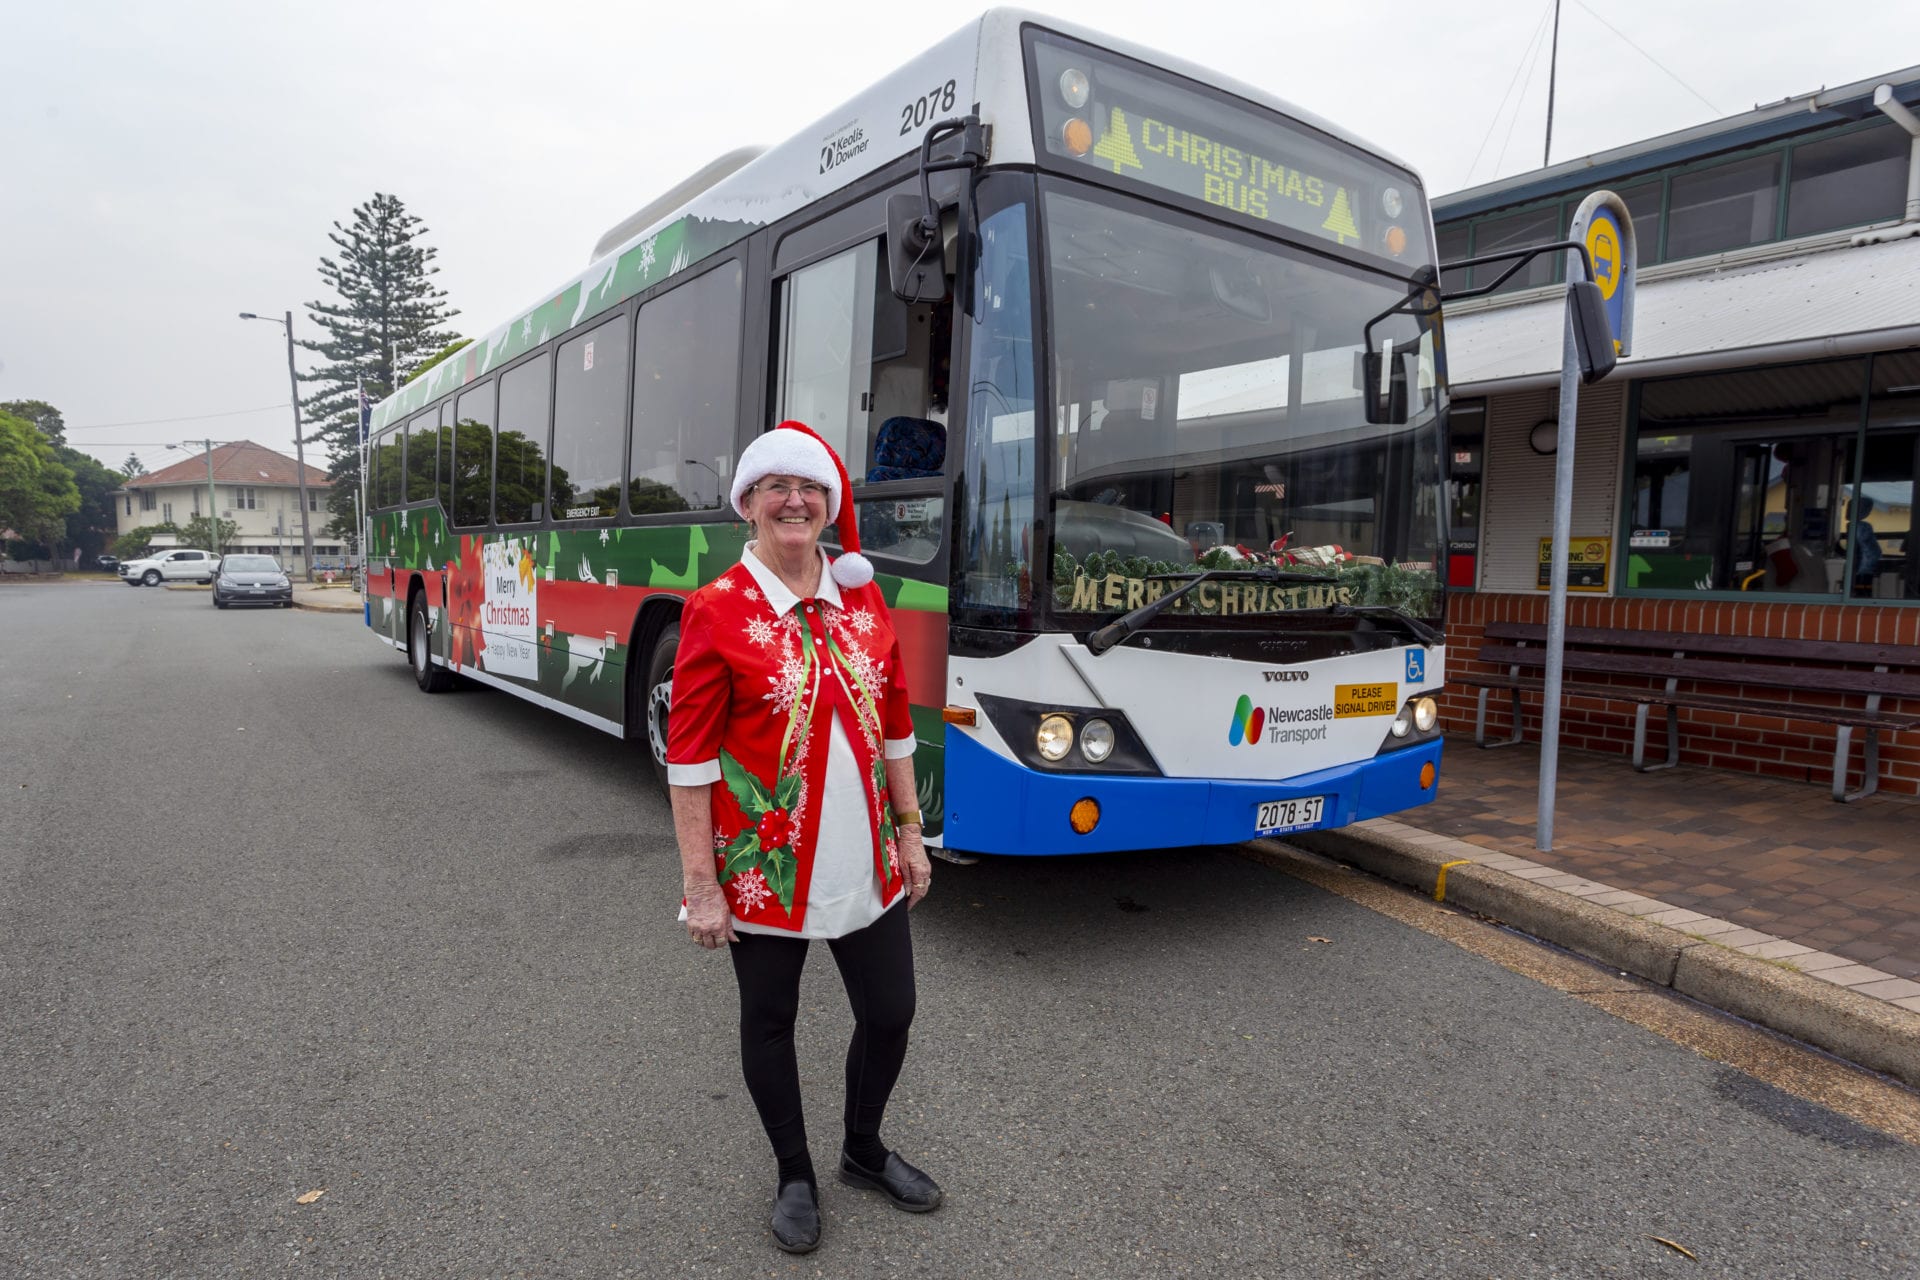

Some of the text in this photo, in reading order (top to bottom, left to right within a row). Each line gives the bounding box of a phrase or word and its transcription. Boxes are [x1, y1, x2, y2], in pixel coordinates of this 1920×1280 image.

[900, 79, 956, 137] 2078
[837, 128, 863, 152] Keolis
[836, 139, 869, 166] Downer
[1142, 118, 1324, 207] CHRISTMAS
[1204, 173, 1269, 220] BUS
[566, 507, 600, 518] EMERGENCY EXIT
[496, 575, 517, 598] Merry
[1199, 580, 1351, 615] CHRISTMAS
[486, 600, 530, 626] Christmas
[1262, 670, 1309, 682] VOLVO
[1352, 687, 1382, 699] PLEASE
[1268, 704, 1333, 724] Newcastle
[1335, 700, 1396, 715] SIGNAL DRIVER
[1268, 724, 1327, 745] Transport
